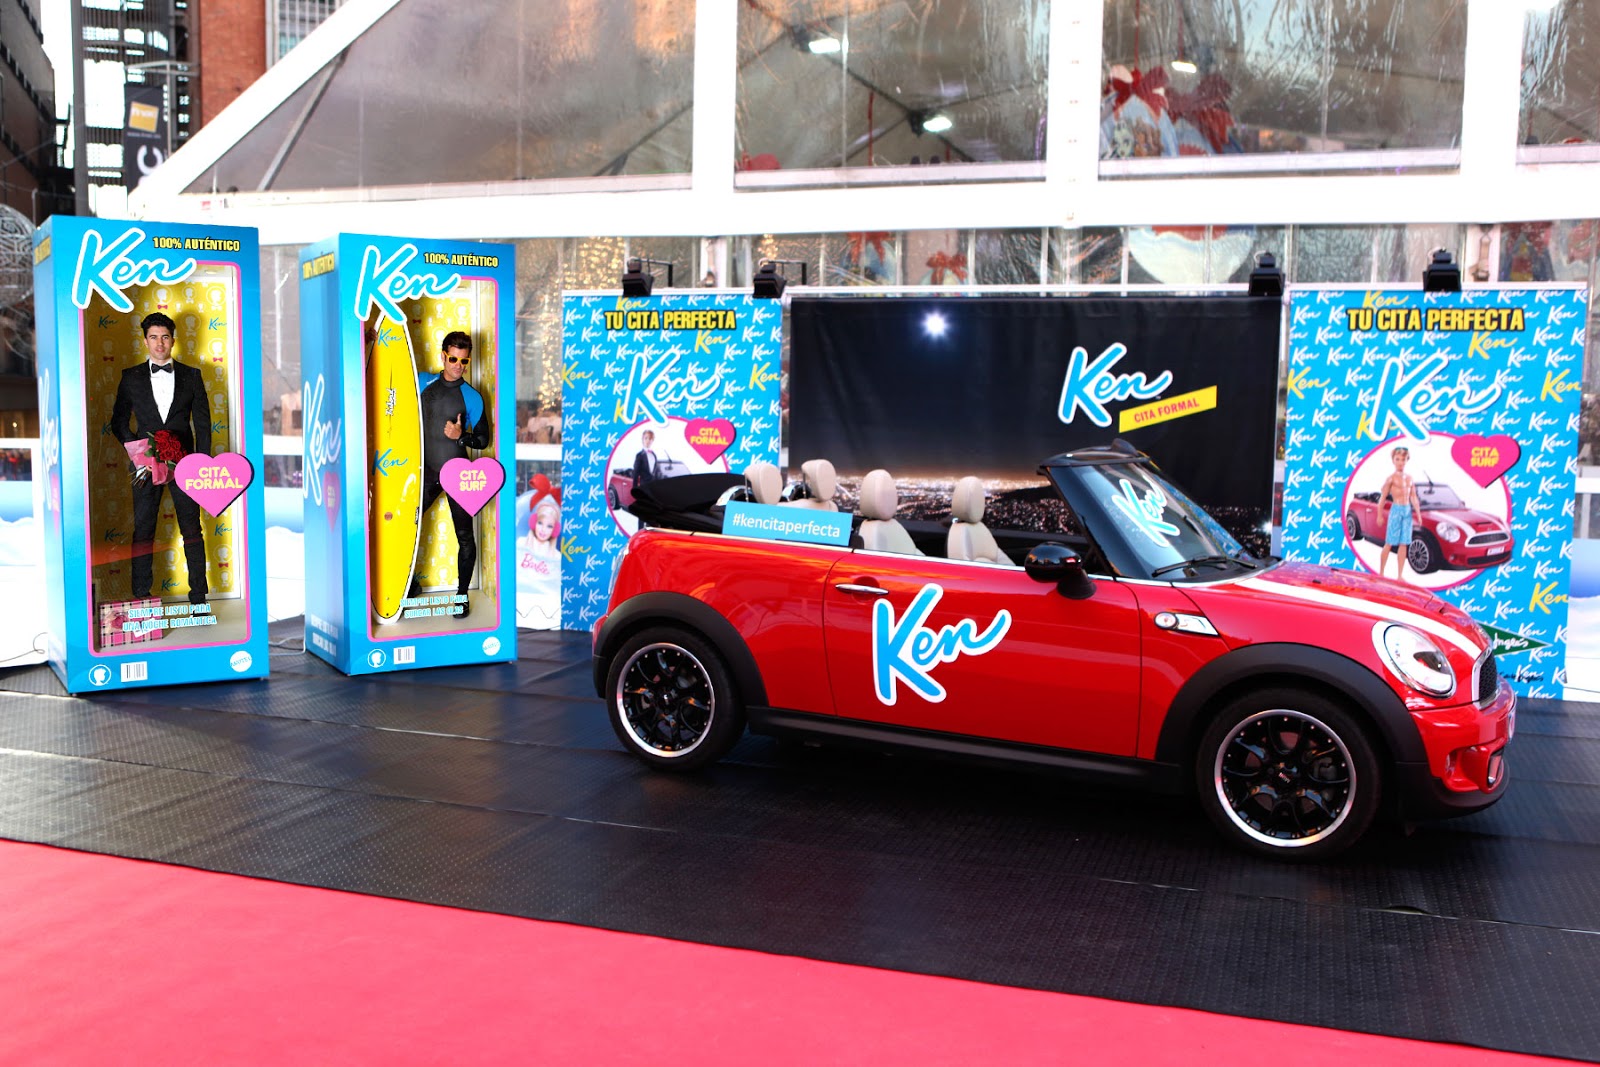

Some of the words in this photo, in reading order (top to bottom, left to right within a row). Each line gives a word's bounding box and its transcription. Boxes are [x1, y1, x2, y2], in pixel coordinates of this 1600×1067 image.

[152, 237, 183, 250] 100%
[184, 236, 241, 252] AUTÉNTICO
[424, 252, 449, 265] 100%
[451, 251, 499, 268] AUTÉNTICO
[72, 228, 197, 313] Ken
[354, 243, 461, 324] Ken
[615, 296, 650, 314] Ken
[1362, 290, 1409, 314] Ken
[565, 308, 585, 325] Ken
[604, 311, 624, 330] TU
[626, 311, 660, 330] CITA
[663, 311, 737, 330] PERFECTA
[752, 306, 775, 324] Ken
[1293, 304, 1321, 325] Ken
[1347, 308, 1373, 331] TU
[1377, 308, 1421, 331] CITA
[1426, 308, 1525, 331] PERFECTA
[1547, 304, 1578, 325] Ken
[378, 328, 402, 347] Ken
[581, 325, 602, 342] Ken
[694, 329, 732, 354] Ken
[742, 325, 764, 342] Ken
[1315, 325, 1343, 345] Ken
[1532, 325, 1563, 346] Ken
[565, 343, 585, 360] Ken
[590, 343, 611, 360] Ken
[616, 343, 637, 360] Ken
[724, 343, 746, 360] Ken
[752, 343, 774, 360] Ken
[1467, 331, 1518, 360] Ken
[1292, 346, 1319, 366] Ken
[1326, 346, 1355, 366] Ken
[1362, 346, 1390, 366] Ken
[1507, 347, 1537, 368] Ken
[1544, 347, 1576, 368] Ken
[561, 361, 594, 389] Ken
[604, 361, 625, 378] Ken
[749, 361, 780, 391] Ken
[1344, 366, 1373, 387] Ken
[587, 379, 608, 396] Ken
[624, 350, 721, 428] Ken
[723, 380, 746, 397] Ken
[1058, 342, 1173, 427] Ken
[1287, 366, 1331, 399] Ken
[1540, 368, 1581, 403] Ken
[581, 396, 601, 413] Ken
[713, 398, 735, 415] Ken
[1321, 387, 1349, 407] Ken
[1380, 351, 1502, 445] Ken
[1505, 389, 1536, 410] Ken
[741, 398, 763, 416] Ken
[1134, 410, 1156, 423] CITA
[1158, 398, 1200, 418] FORMAL
[564, 413, 584, 430] Ken
[589, 413, 610, 431] Ken
[750, 416, 773, 434] Ken
[1312, 407, 1340, 427] Ken
[1491, 411, 1521, 431] Ken
[1528, 411, 1559, 432] Ken
[302, 373, 341, 506] Ken
[580, 431, 600, 448] Ken
[690, 435, 729, 446] FORMAL
[699, 427, 721, 437] CITA
[1289, 427, 1316, 447] Ken
[1323, 428, 1351, 448] Ken
[740, 434, 763, 452] Ken
[1541, 432, 1571, 453] Ken
[563, 448, 583, 465] Ken
[589, 449, 610, 466] Ken
[1310, 448, 1338, 468] Ken
[1471, 447, 1499, 458] CITA
[372, 449, 408, 476] Ken
[1470, 457, 1499, 468] SURF
[1526, 454, 1556, 474] Ken
[198, 466, 230, 479] CITA
[459, 470, 486, 481] CITA
[580, 466, 600, 483] Ken
[1287, 468, 1314, 488] Ken
[1322, 469, 1349, 489] Ken
[185, 477, 243, 491] FORMAL
[459, 480, 487, 492] SURF
[563, 483, 583, 500] Ken
[1538, 475, 1568, 496] Ken
[1308, 489, 1336, 509] Ken
[1524, 496, 1554, 516] Ken
[579, 501, 600, 518] Ken
[1111, 473, 1181, 548] Ken
[1286, 509, 1313, 528] Ken
[563, 518, 583, 535] Ken
[588, 519, 608, 536] Ken
[732, 513, 840, 538] #kencitaperfecta
[1536, 517, 1566, 538] Ken
[561, 535, 592, 562] Ken
[602, 537, 623, 554] Ken
[1306, 530, 1334, 549] Ken
[1521, 538, 1551, 558] Ken
[521, 553, 550, 575] Barbie
[586, 554, 606, 570] Ken
[1533, 560, 1564, 580] Ken
[579, 571, 599, 587] Ken
[1482, 578, 1512, 598] Ken
[563, 587, 582, 603] Ken
[588, 588, 608, 605] Ken
[1529, 581, 1568, 614] Ken
[128, 607, 164, 618] SIEMPRE
[165, 605, 188, 616] LISTO
[189, 603, 211, 614] PARA
[579, 605, 599, 622] Ken
[1494, 600, 1524, 619] Ken
[141, 618, 169, 630] NOCHE
[170, 615, 217, 629] ROMÁNTICA
[872, 583, 1012, 706] Ken
